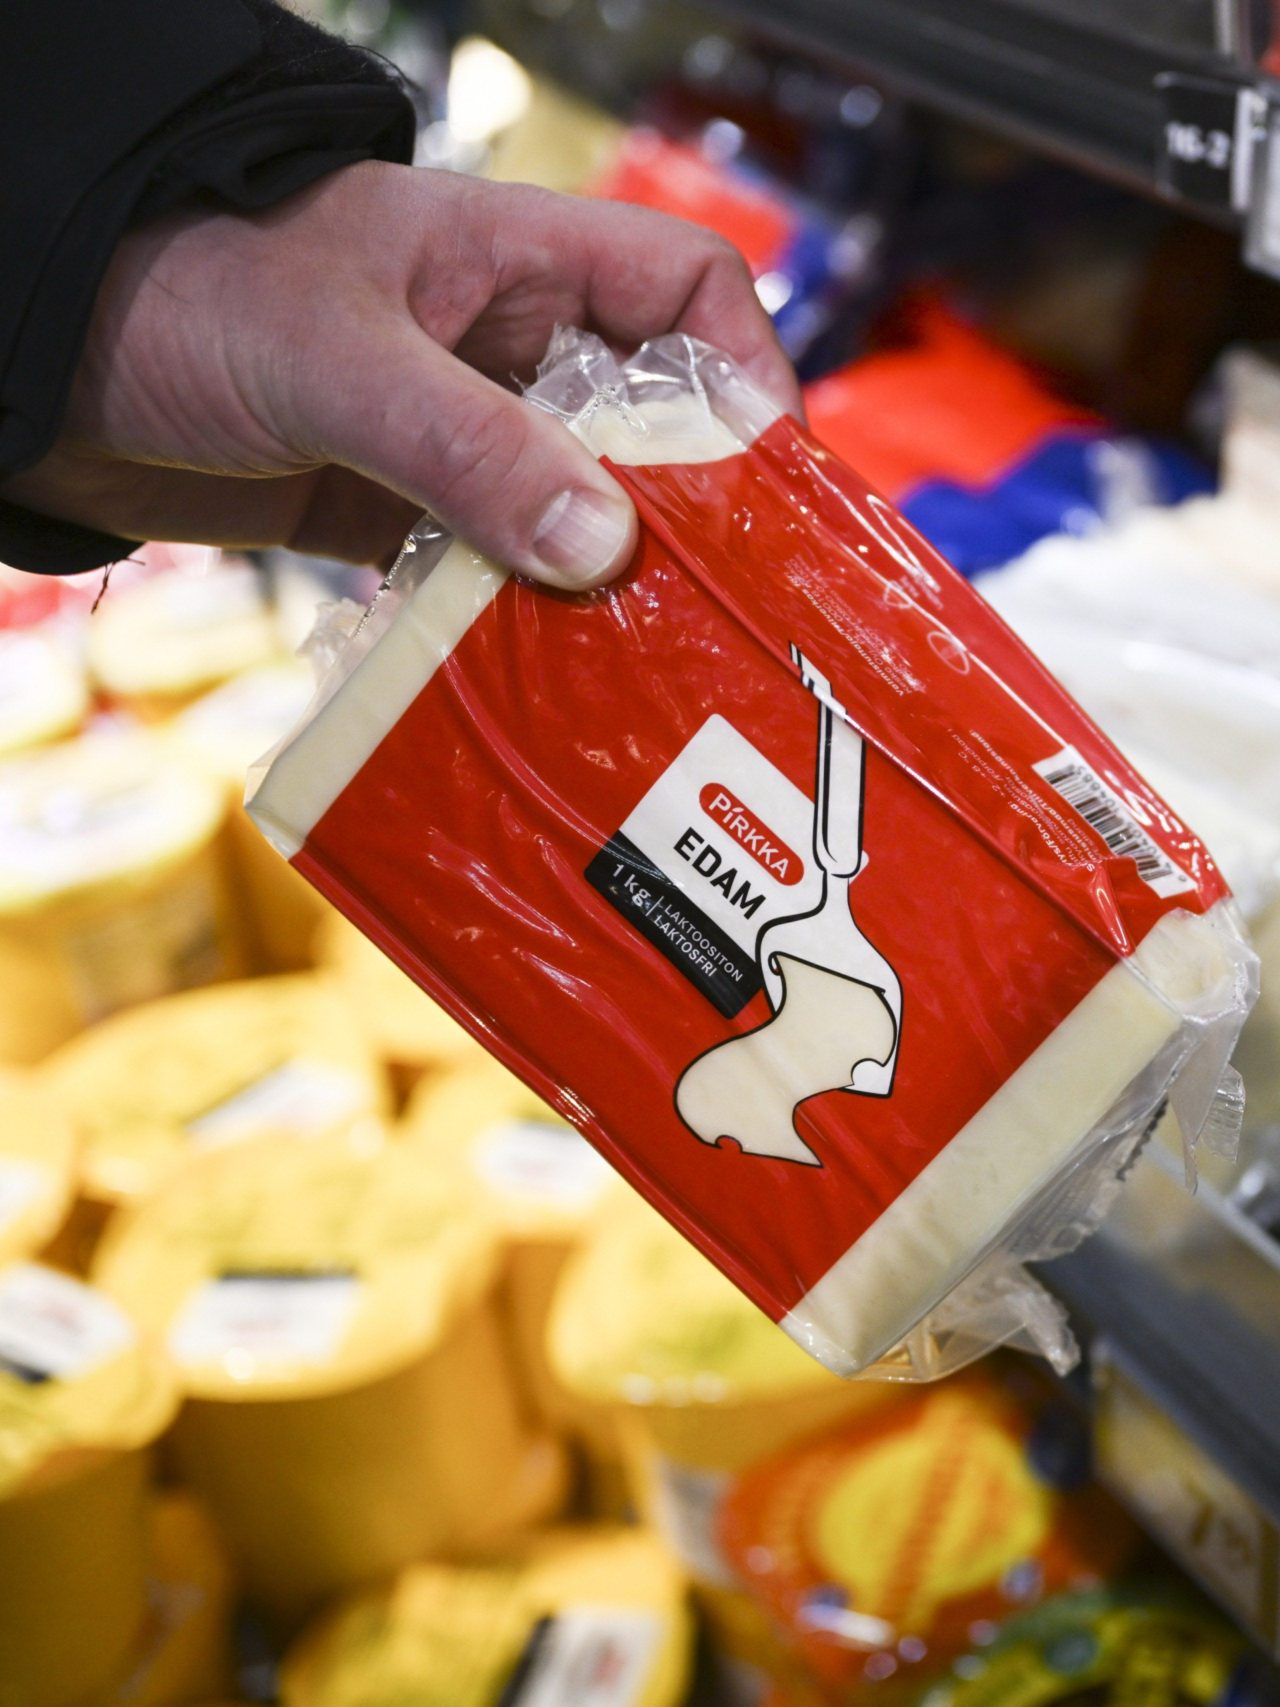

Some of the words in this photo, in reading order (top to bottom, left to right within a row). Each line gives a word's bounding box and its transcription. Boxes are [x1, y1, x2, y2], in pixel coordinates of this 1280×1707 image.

[612, 863, 624, 878] 1
[624, 874, 652, 908] kg
[673, 827, 767, 920] EDAM
[654, 914, 718, 978] LAKTOSFRI
[664, 904, 744, 983] LAKTOOSITON
